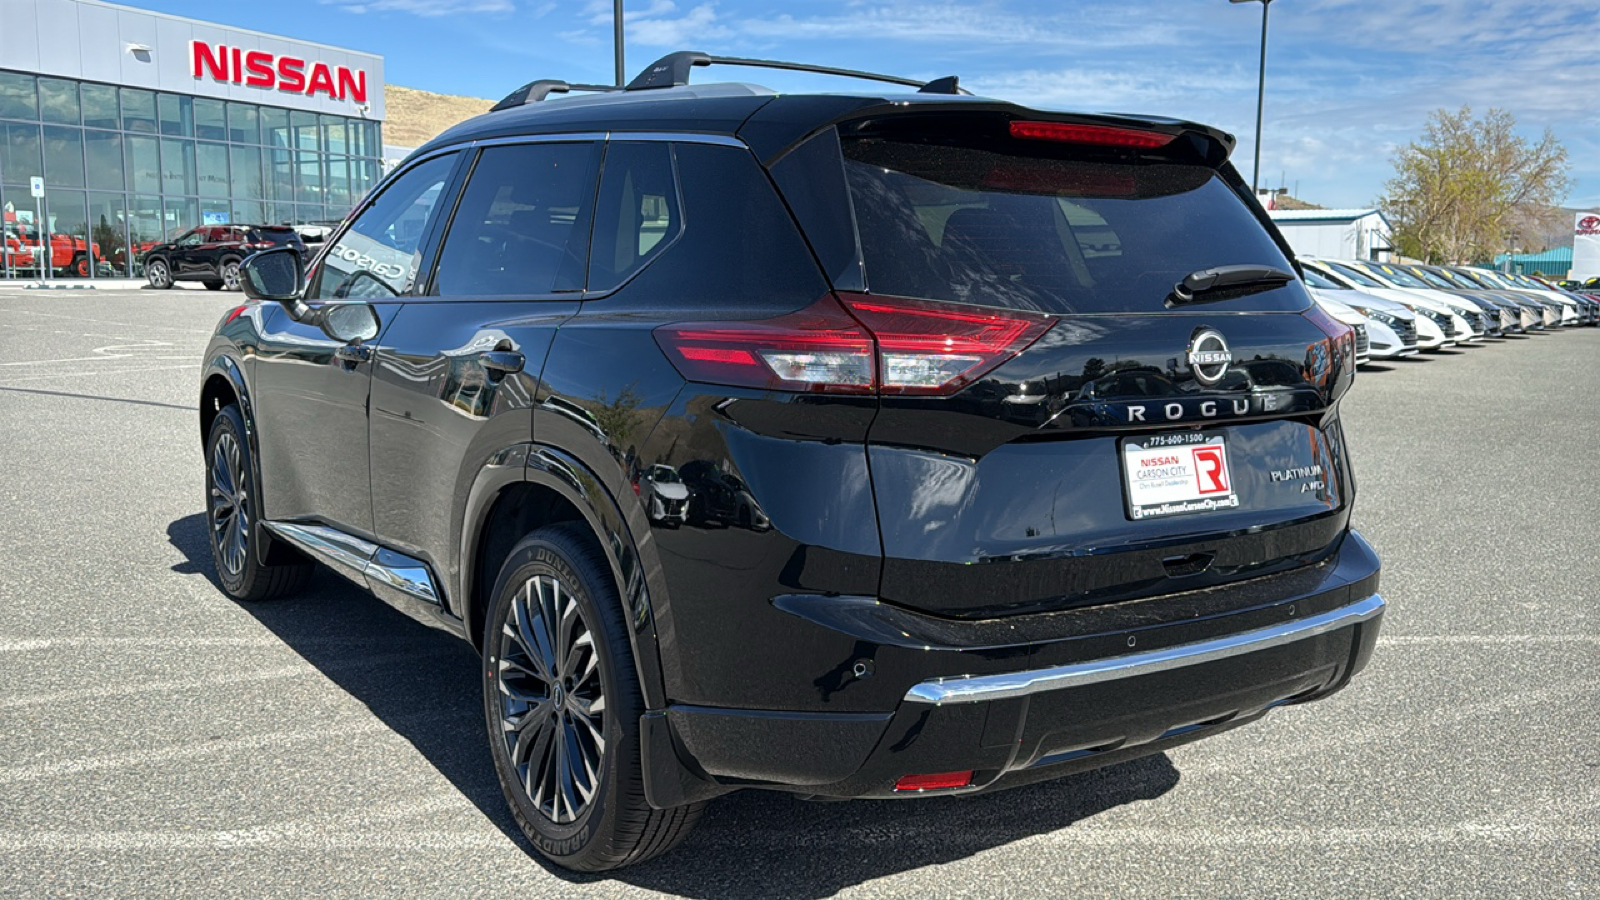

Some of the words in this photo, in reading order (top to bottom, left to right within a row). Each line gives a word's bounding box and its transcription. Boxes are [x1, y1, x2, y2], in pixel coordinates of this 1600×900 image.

[191, 41, 367, 103] NISSAN
[1190, 352, 1232, 364] NISSAN
[1127, 395, 1277, 421] ROGUE
[1150, 433, 1204, 446] 775-600-1500
[1141, 456, 1180, 467] NISSAN
[1136, 468, 1169, 479] CARSON
[1170, 465, 1187, 476] CITY
[1270, 465, 1322, 482] PLATINUM
[1301, 481, 1325, 494] AWD
